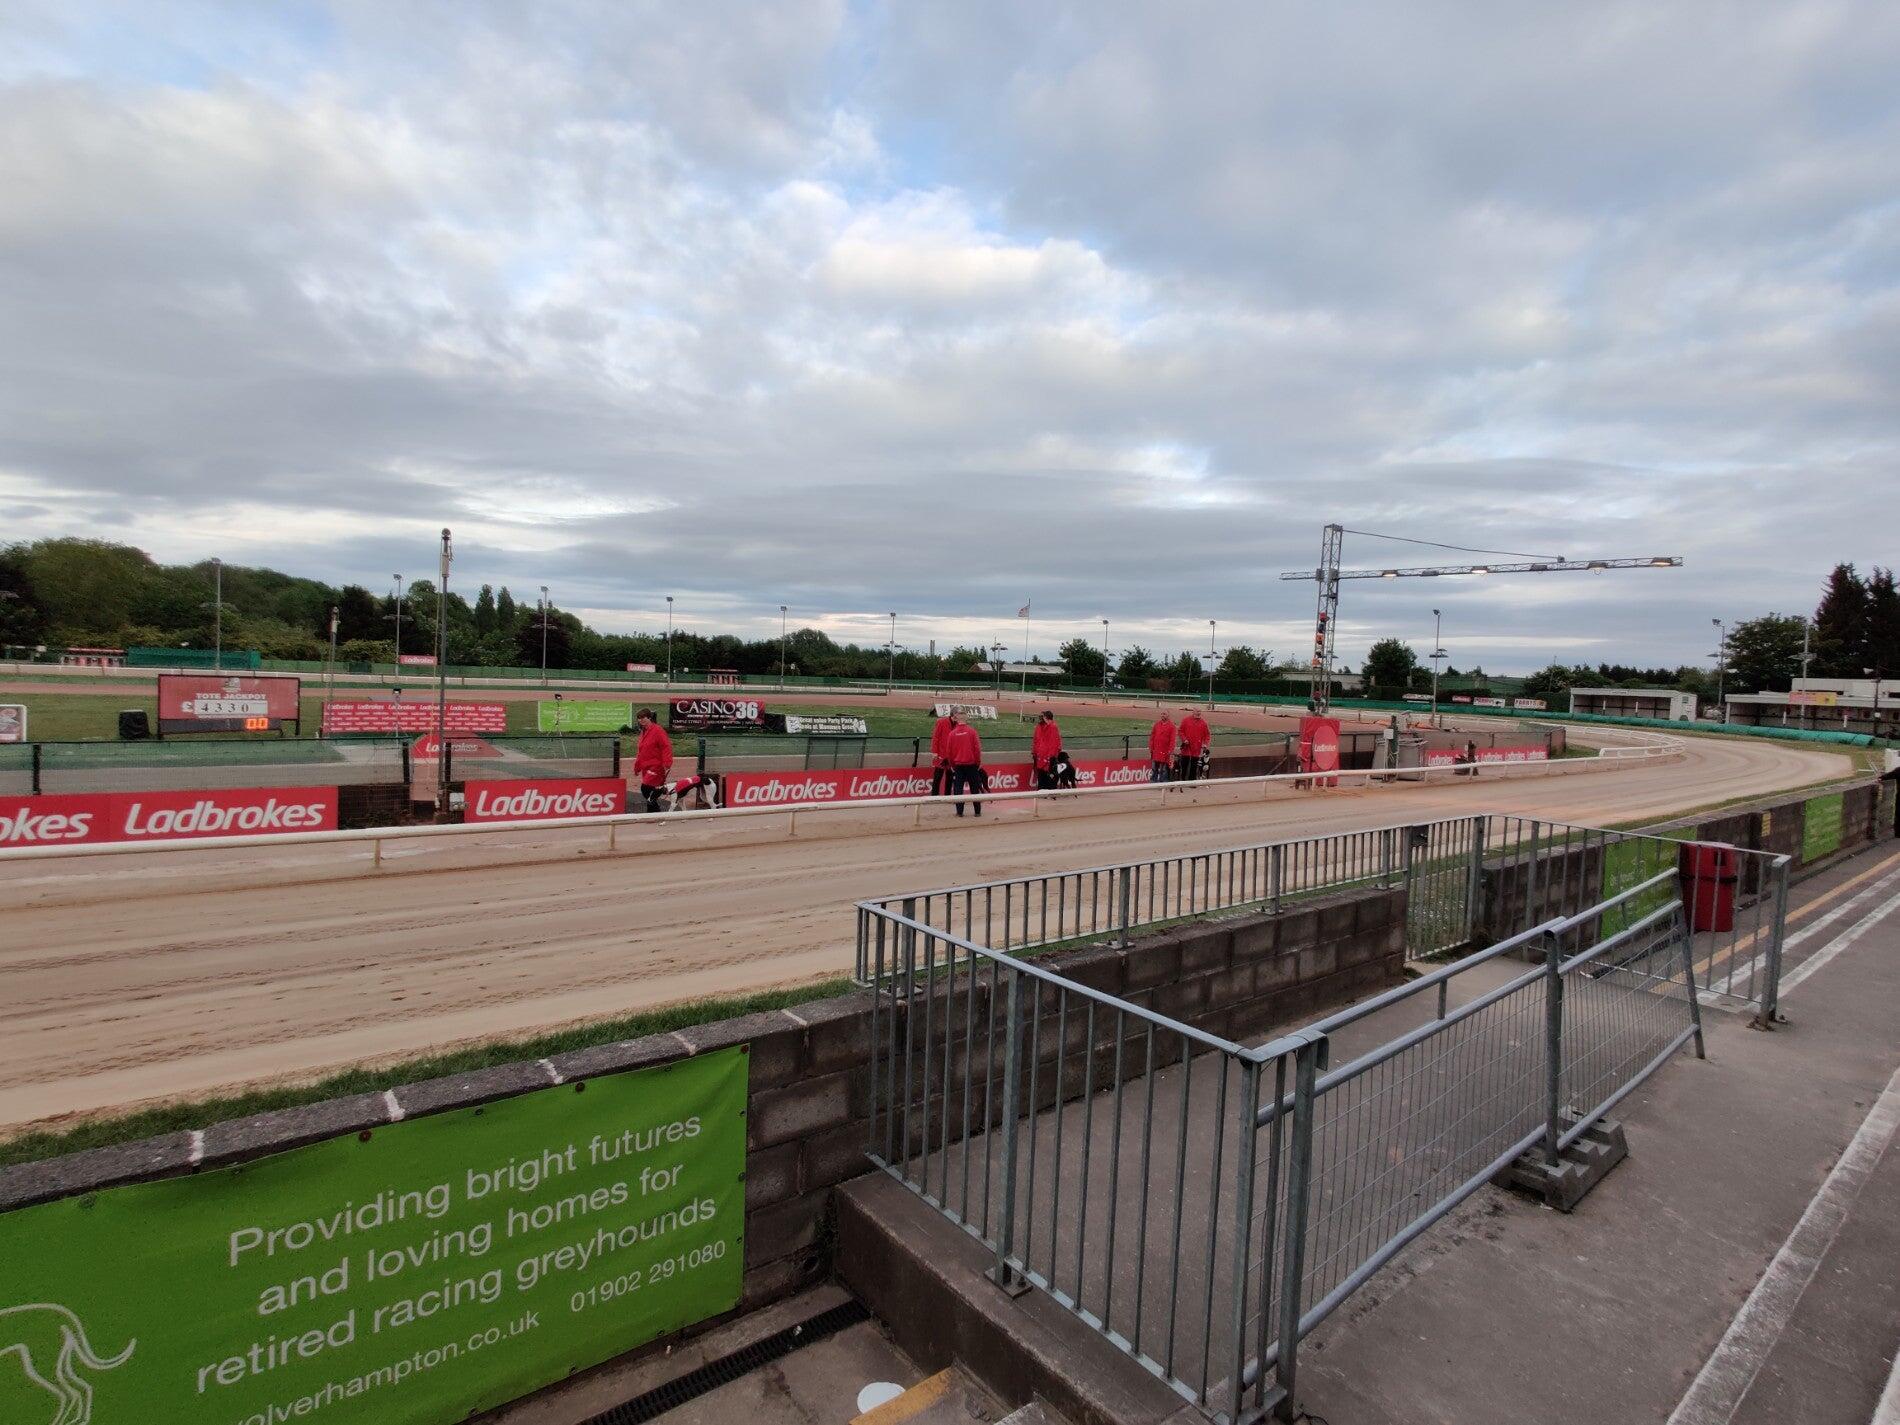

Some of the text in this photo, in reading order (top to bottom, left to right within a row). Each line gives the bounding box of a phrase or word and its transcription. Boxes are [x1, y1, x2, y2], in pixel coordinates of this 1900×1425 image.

[476, 788, 618, 816] Ladbrokes
[733, 778, 837, 803] Ladbrokes
[849, 775, 933, 797] Ladbrokes
[124, 798, 326, 835] Ladbrokes
[229, 1116, 702, 1267] Providing bright futures
[257, 1163, 684, 1315] and loving homes for
[197, 1197, 716, 1394] retired racing greyhounds
[570, 1270, 642, 1312] 01902
[648, 1240, 726, 1285] 291080
